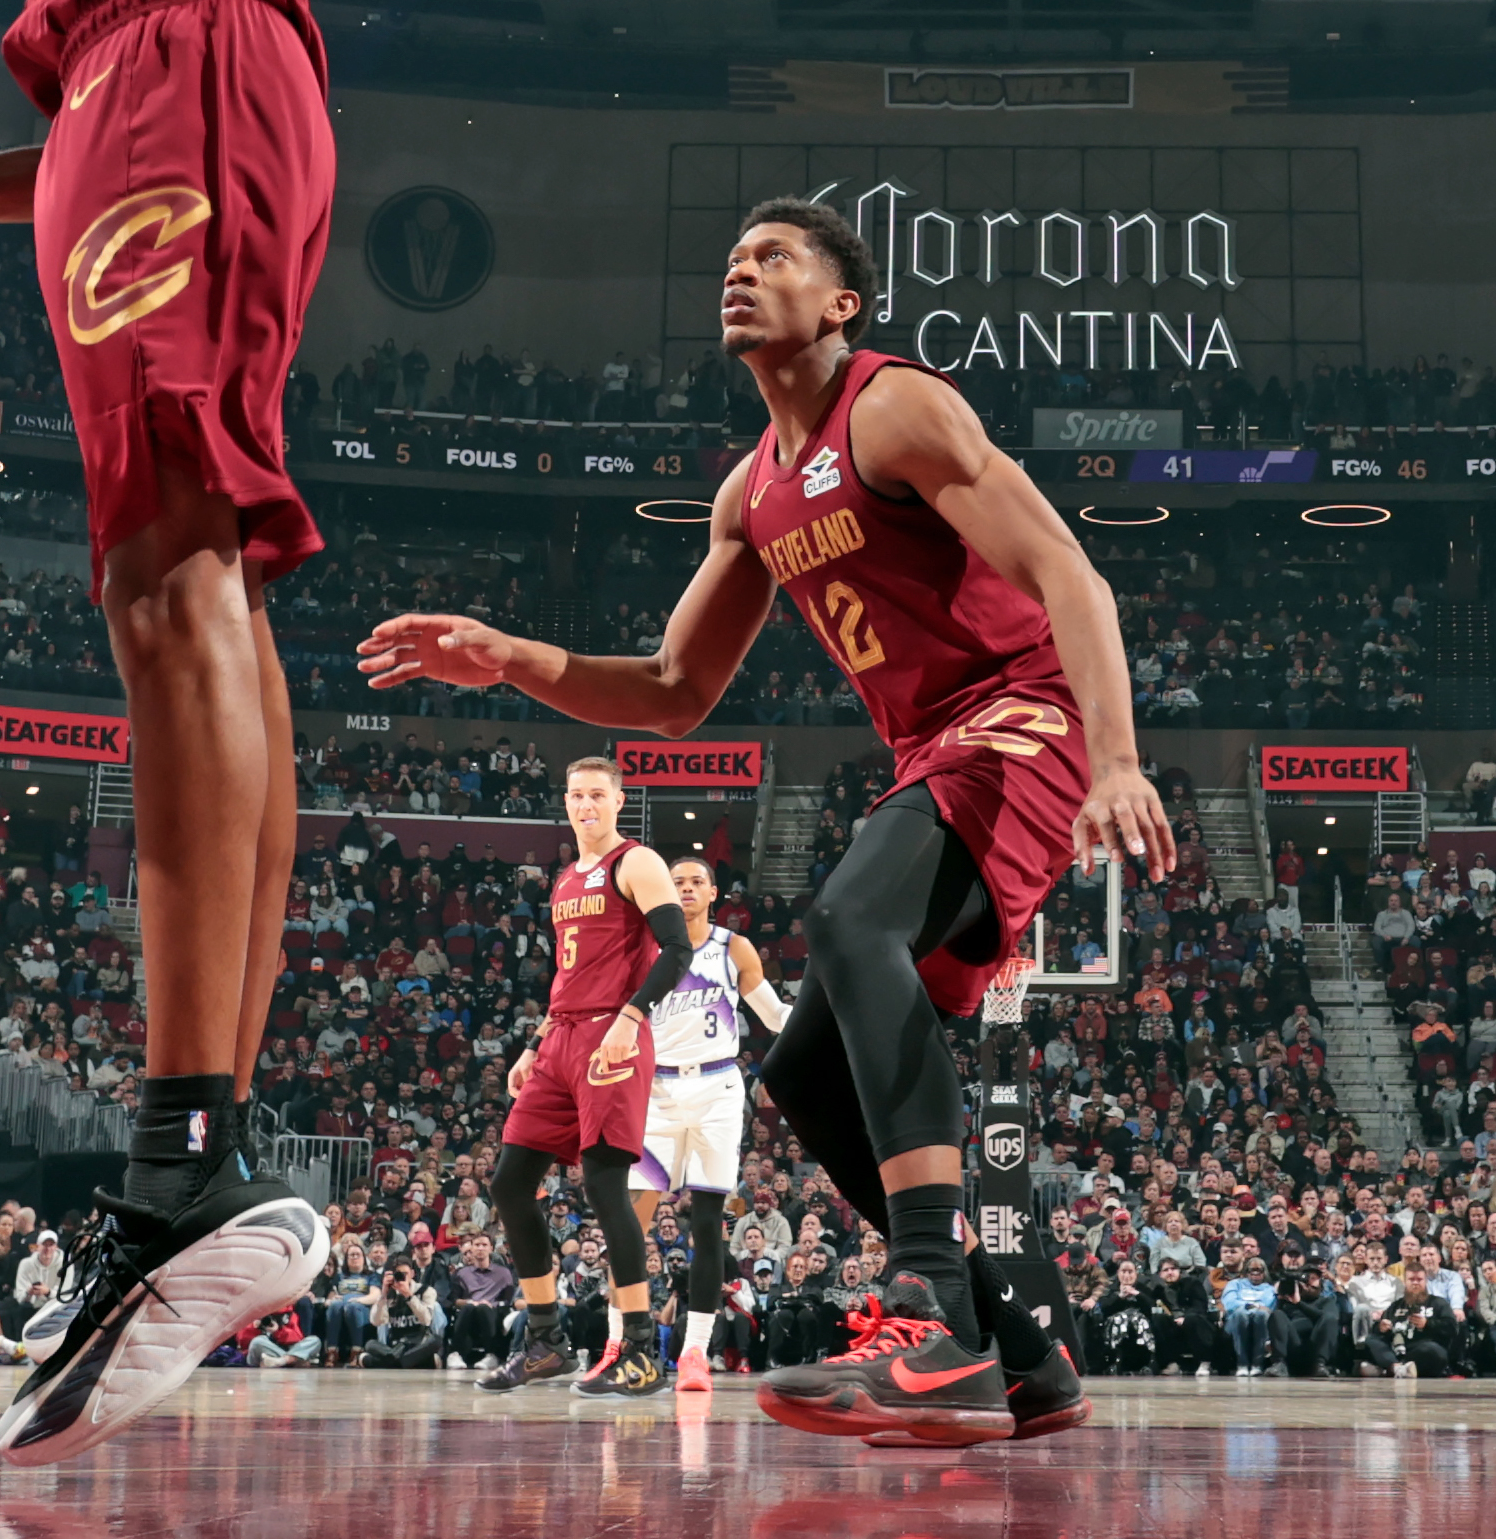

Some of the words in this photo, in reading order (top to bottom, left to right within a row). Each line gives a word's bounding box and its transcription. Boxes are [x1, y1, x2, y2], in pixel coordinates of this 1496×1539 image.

[915, 310, 1241, 371] CANTINA
[1060, 411, 1157, 447] Sprite
[332, 440, 375, 460] TOL
[396, 444, 410, 464] 5
[446, 448, 517, 469] FOULS
[537, 453, 552, 473] 0
[584, 456, 634, 473] FG%
[653, 456, 682, 474] 43
[1077, 455, 1115, 478] 2Q
[1163, 456, 1193, 478] 41
[1331, 459, 1382, 476] FG%
[1397, 459, 1427, 479] 46
[805, 471, 839, 493] CLIFFS
[759, 507, 866, 585] CLEVELAND
[346, 714, 390, 731] M113
[623, 750, 753, 778] SEATGEEK
[1269, 756, 1400, 782] SEATGEEK
[552, 894, 605, 924] CLEVELAND
[563, 926, 579, 970] 5
[703, 952, 721, 960] LVT
[652, 987, 724, 1026] UTAH
[704, 1012, 718, 1038] 3
[991, 1094, 1018, 1104] GEEK
[992, 1085, 1017, 1095] SEAT
[988, 1137, 1022, 1163] ups
[981, 1231, 1024, 1254] Elk
